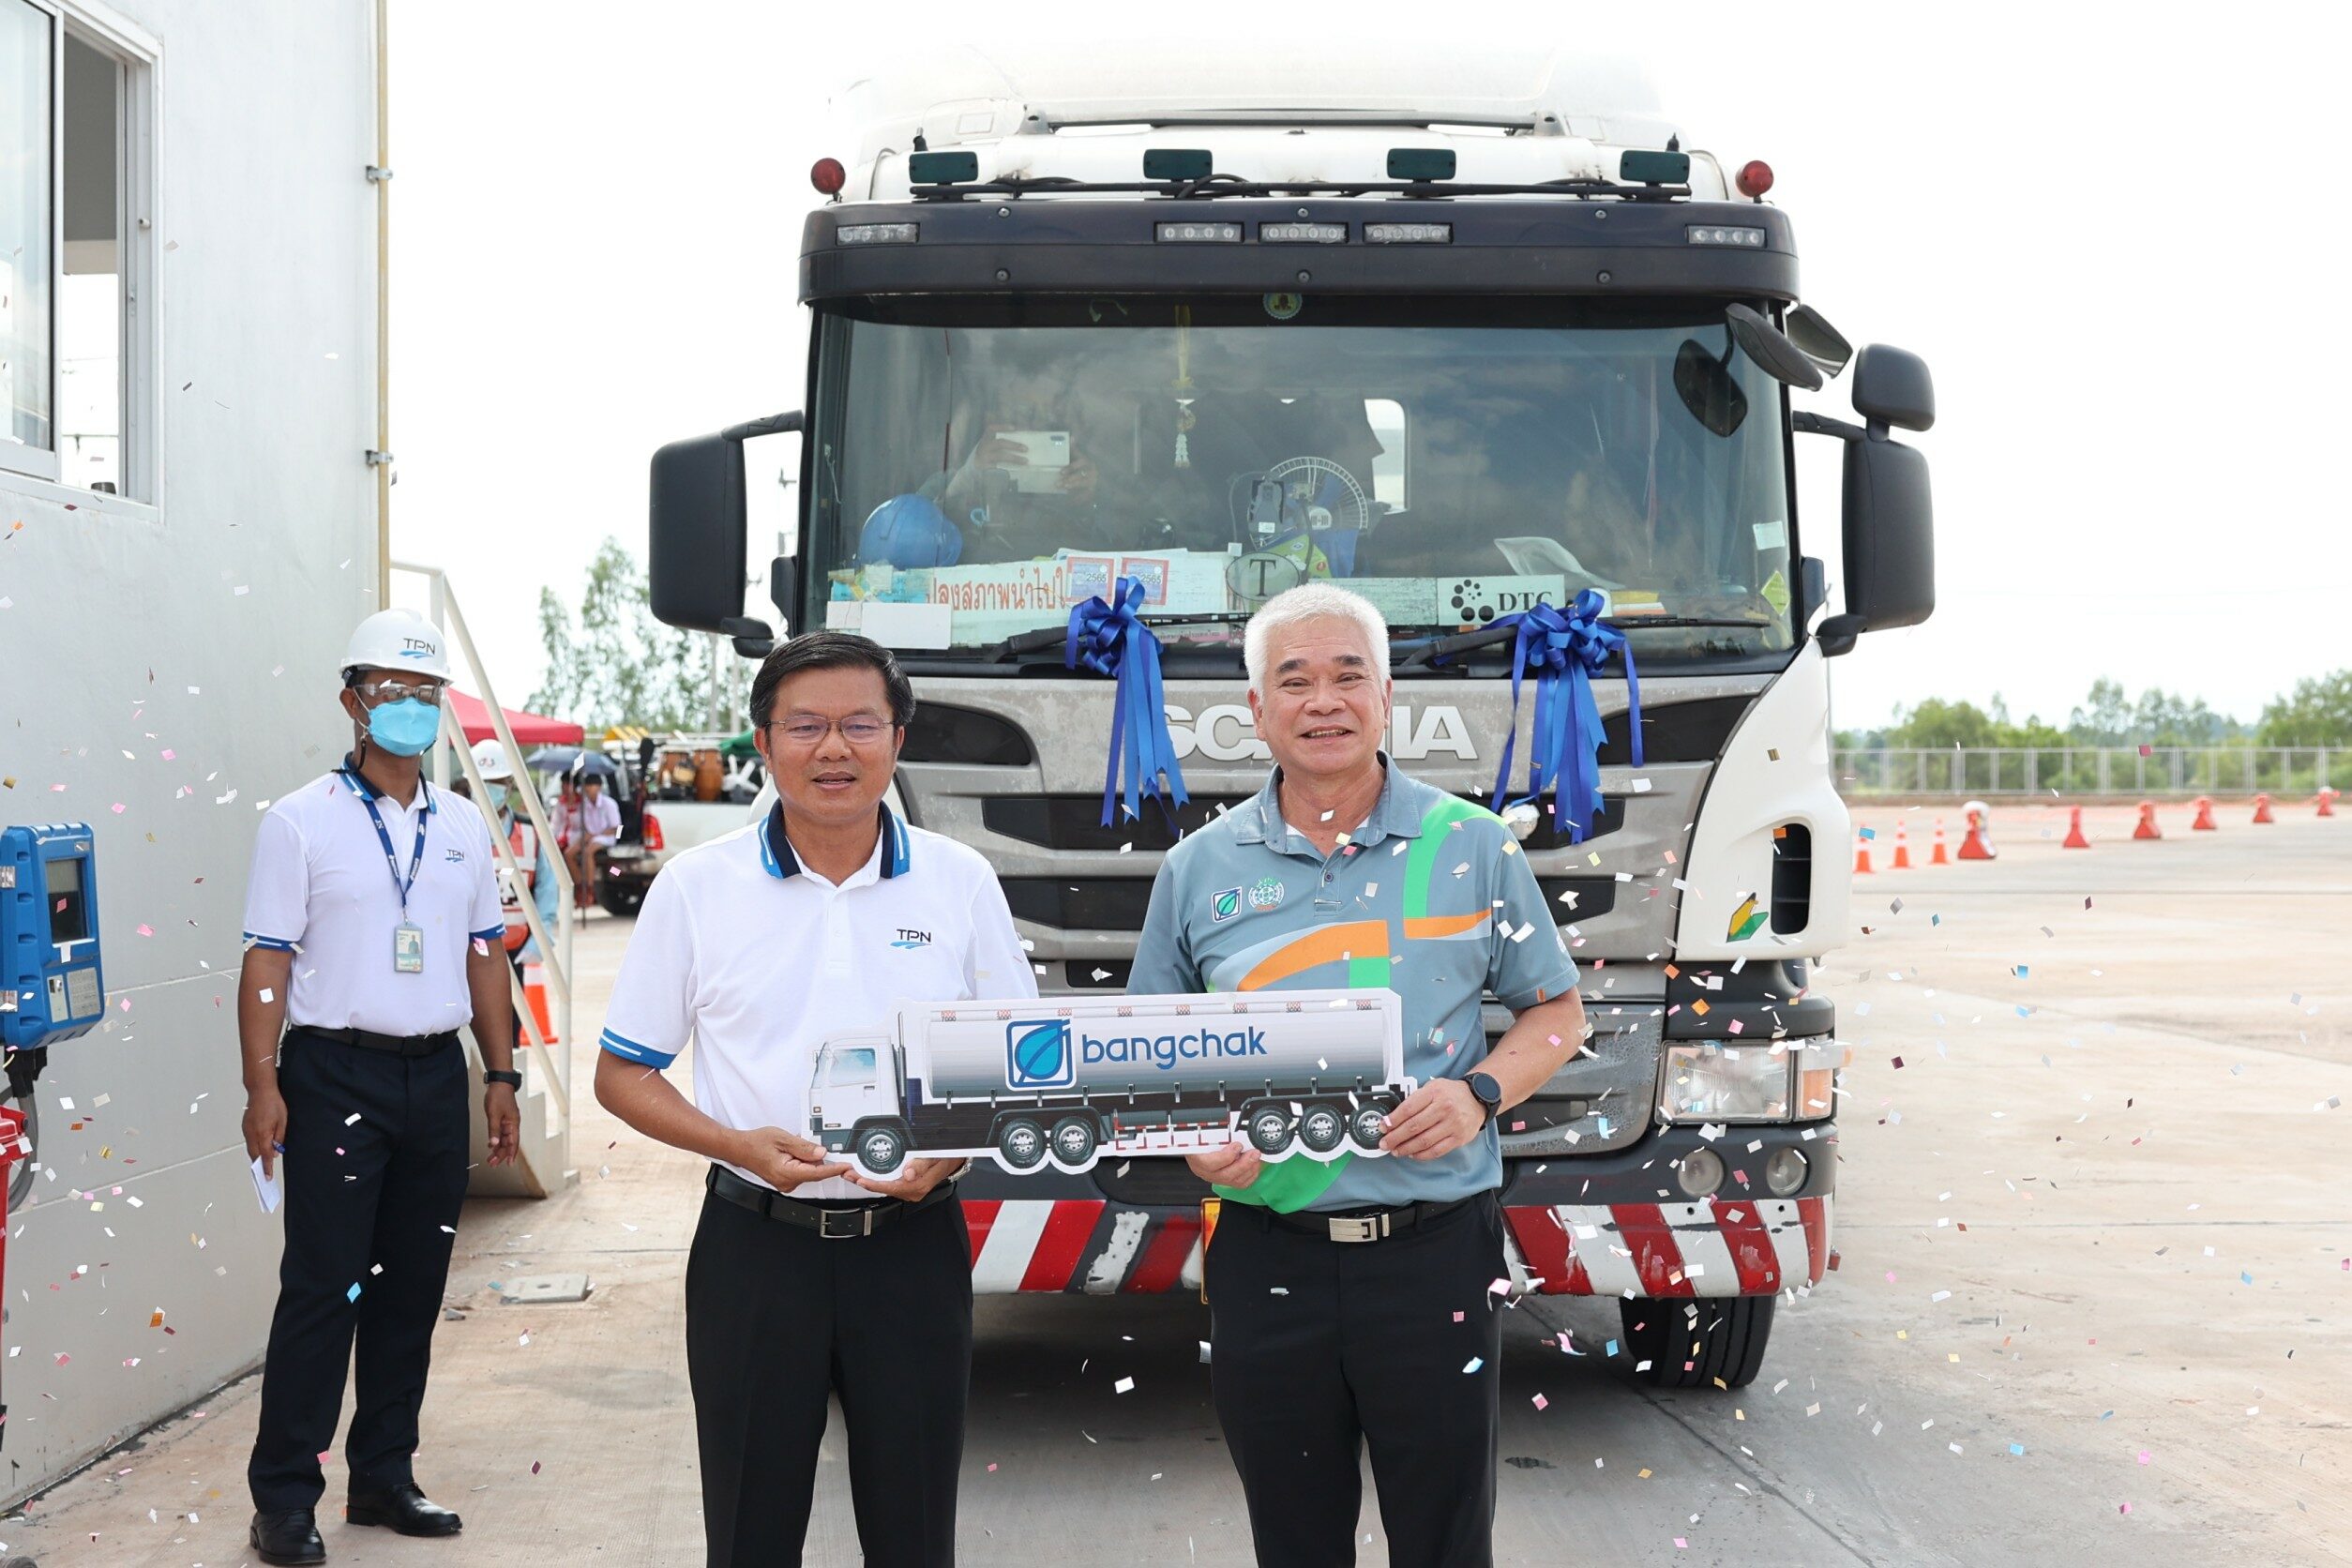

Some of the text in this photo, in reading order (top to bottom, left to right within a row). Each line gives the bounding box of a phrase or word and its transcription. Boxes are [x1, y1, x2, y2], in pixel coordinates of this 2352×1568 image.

[1086, 574, 1107, 582] 2565
[1141, 574, 1162, 583] 2565
[1249, 559, 1276, 596] T
[403, 638, 436, 656] TPN
[1164, 704, 1478, 761] SCIA
[446, 849, 465, 859] TPN
[897, 928, 931, 943] TPN
[1082, 1026, 1267, 1070] bangchak
